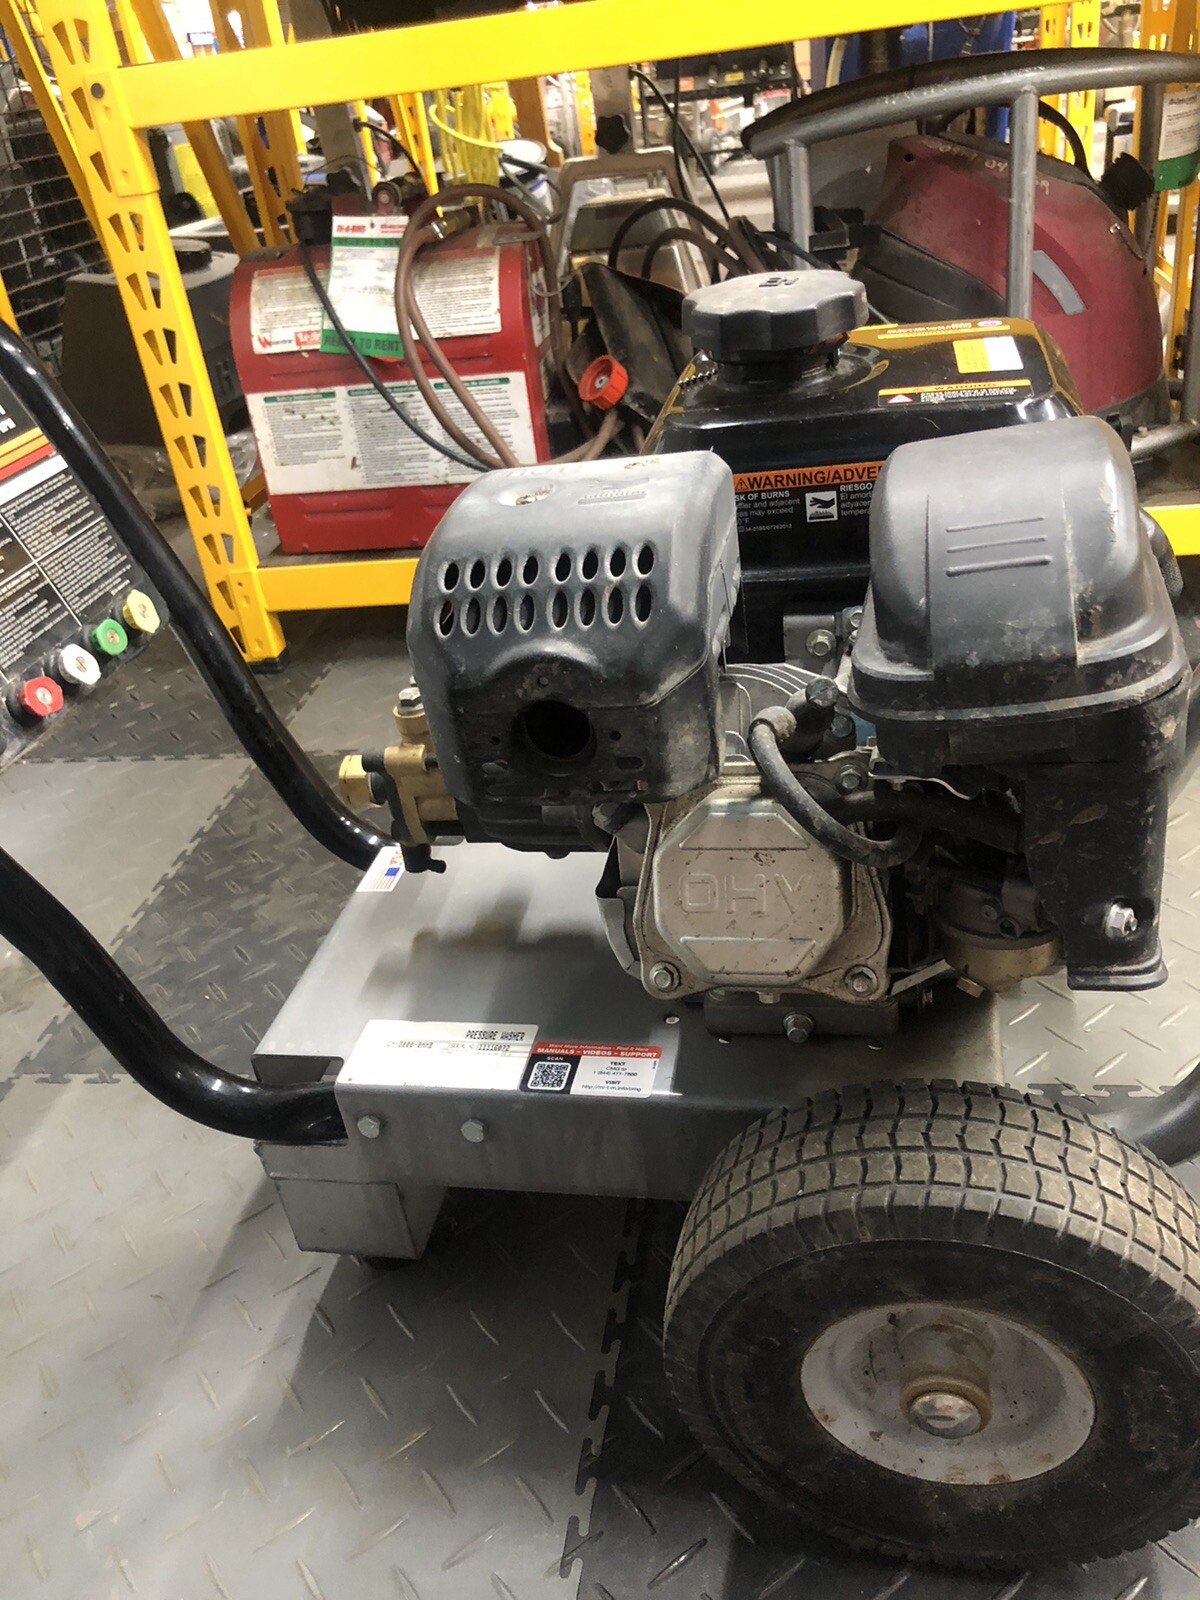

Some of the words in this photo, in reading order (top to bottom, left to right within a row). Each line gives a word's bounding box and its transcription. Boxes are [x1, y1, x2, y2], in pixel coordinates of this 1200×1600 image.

[374, 339, 400, 351] RENT
[747, 465, 882, 490] WARNING/ADVE
[840, 483, 873, 491] RIESGO
[761, 490, 790, 500] BURNS
[769, 498, 800, 507] adjacent
[767, 507, 793, 515] exceed
[679, 873, 812, 914] OHV
[465, 1030, 498, 1040] PRESSURE
[500, 1031, 526, 1041] WASHER
